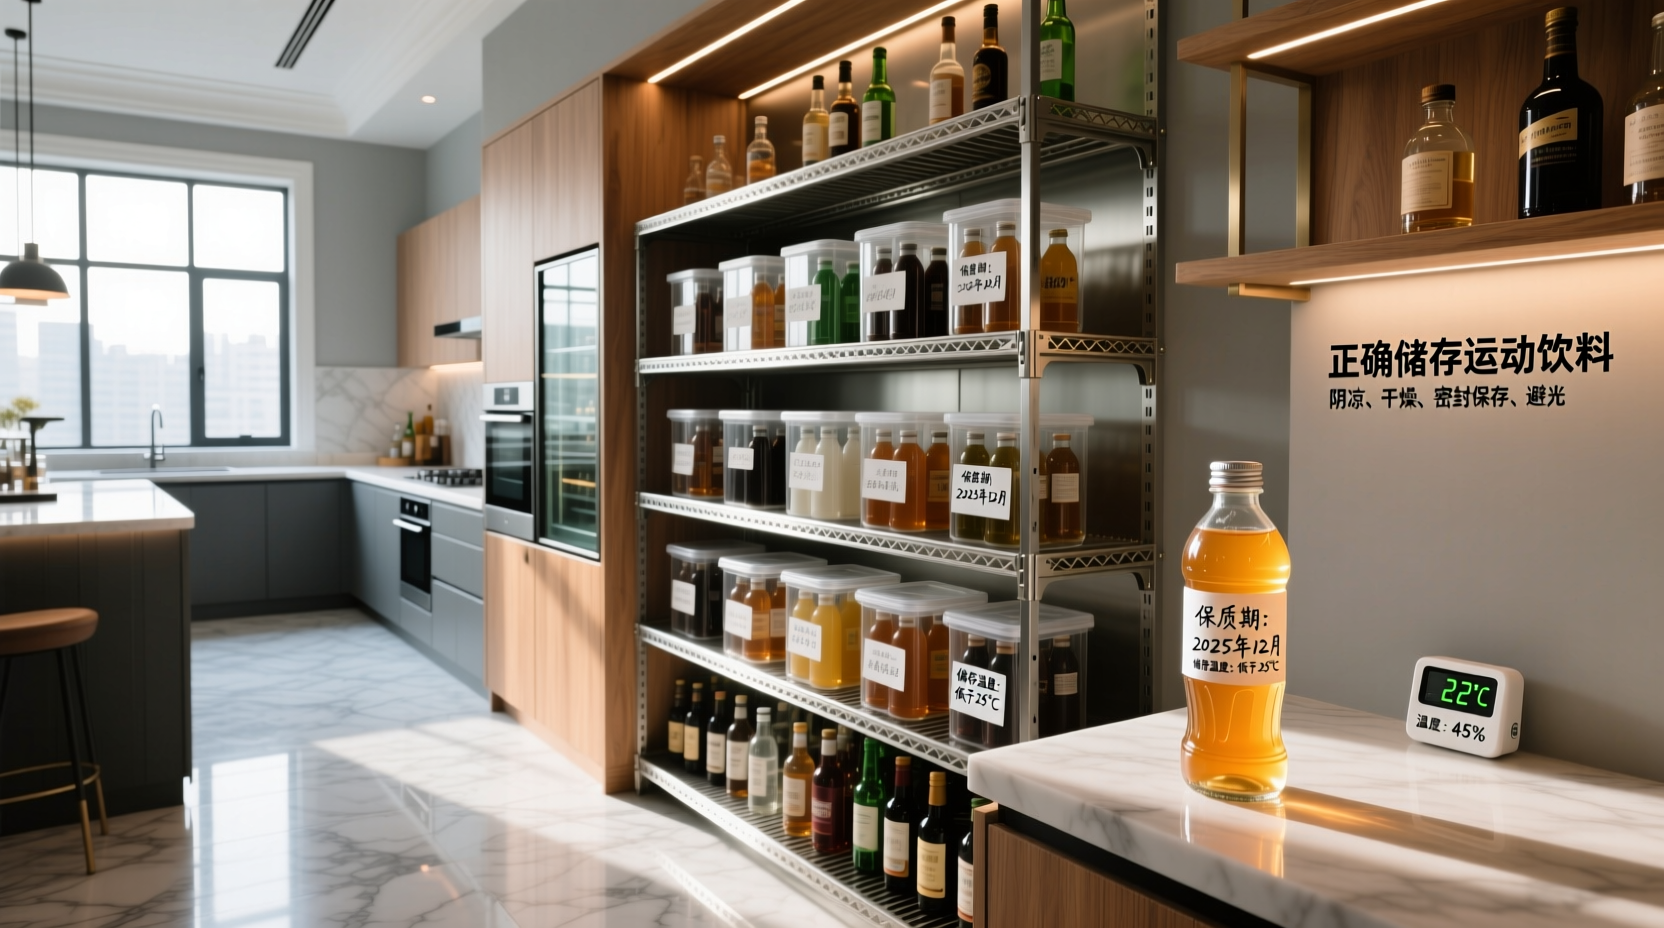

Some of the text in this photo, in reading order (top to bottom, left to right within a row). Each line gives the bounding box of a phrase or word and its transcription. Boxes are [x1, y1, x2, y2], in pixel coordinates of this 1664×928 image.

[1328, 331, 1615, 379] 正确储存运动饮料
[1329, 384, 1567, 410] 阴凉、干燥、密封保存、避光
[1194, 604, 1269, 631] 保质期:
[1192, 634, 1281, 659] 2025年12月
[1440, 678, 1490, 708] 22°C
